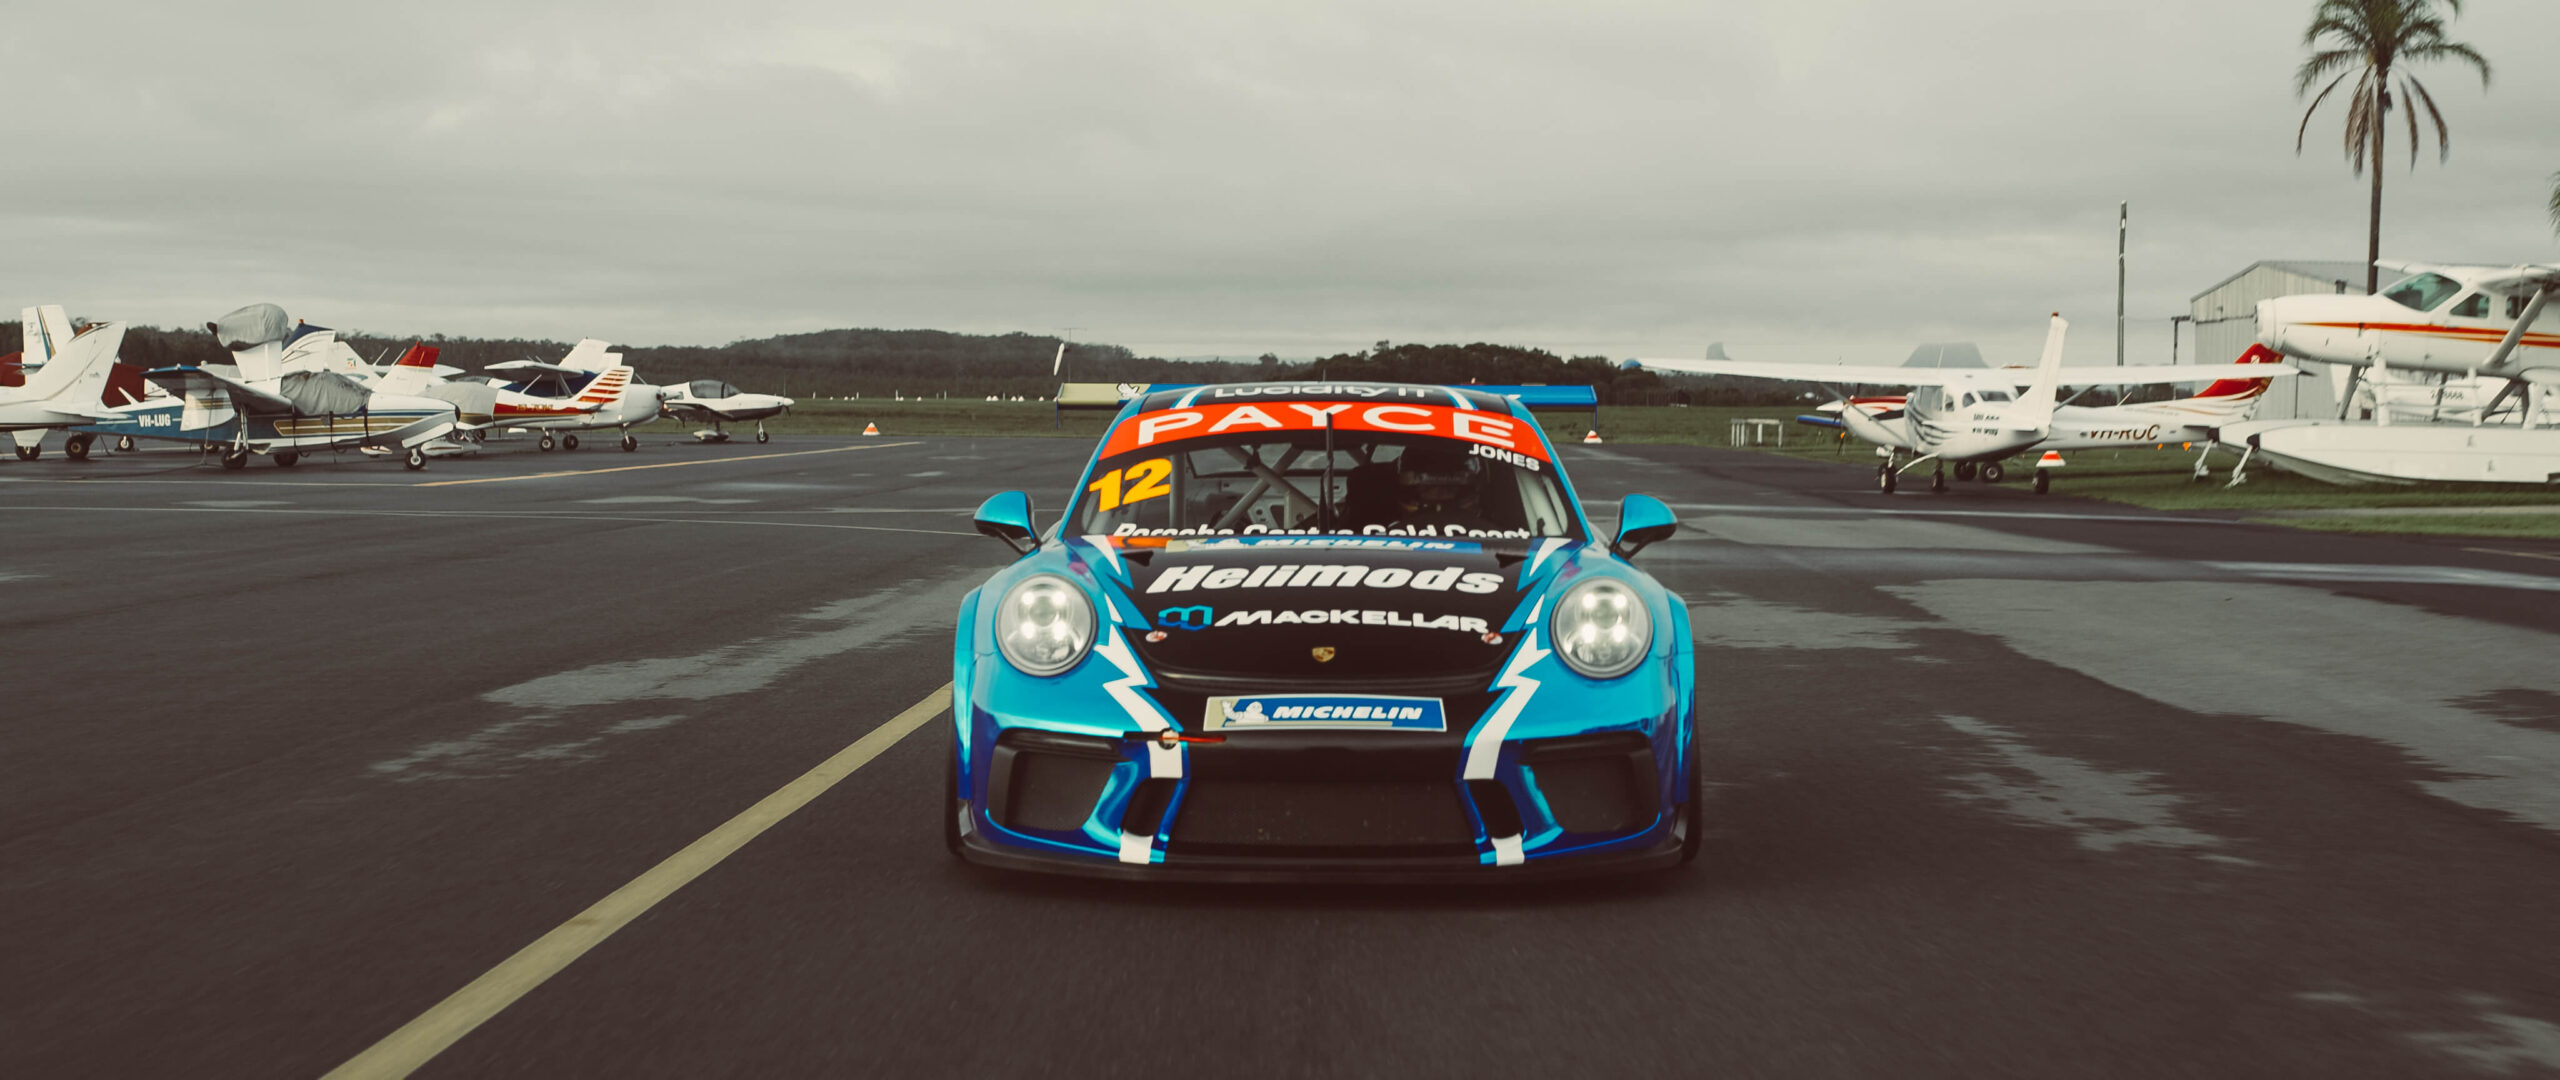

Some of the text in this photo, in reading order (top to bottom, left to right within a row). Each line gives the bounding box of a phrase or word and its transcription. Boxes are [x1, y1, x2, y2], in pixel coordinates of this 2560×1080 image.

[1215, 385, 1433, 398] Lucidity IT
[138, 413, 171, 427] VH-LUG
[1138, 404, 1515, 448] PAYCE
[1469, 443, 1540, 471] JONES
[1088, 458, 1173, 513] 12
[1146, 564, 1504, 594] HeliMods
[1214, 609, 1489, 634] MACKELLAR
[1272, 706, 1423, 720] MICHELIN
